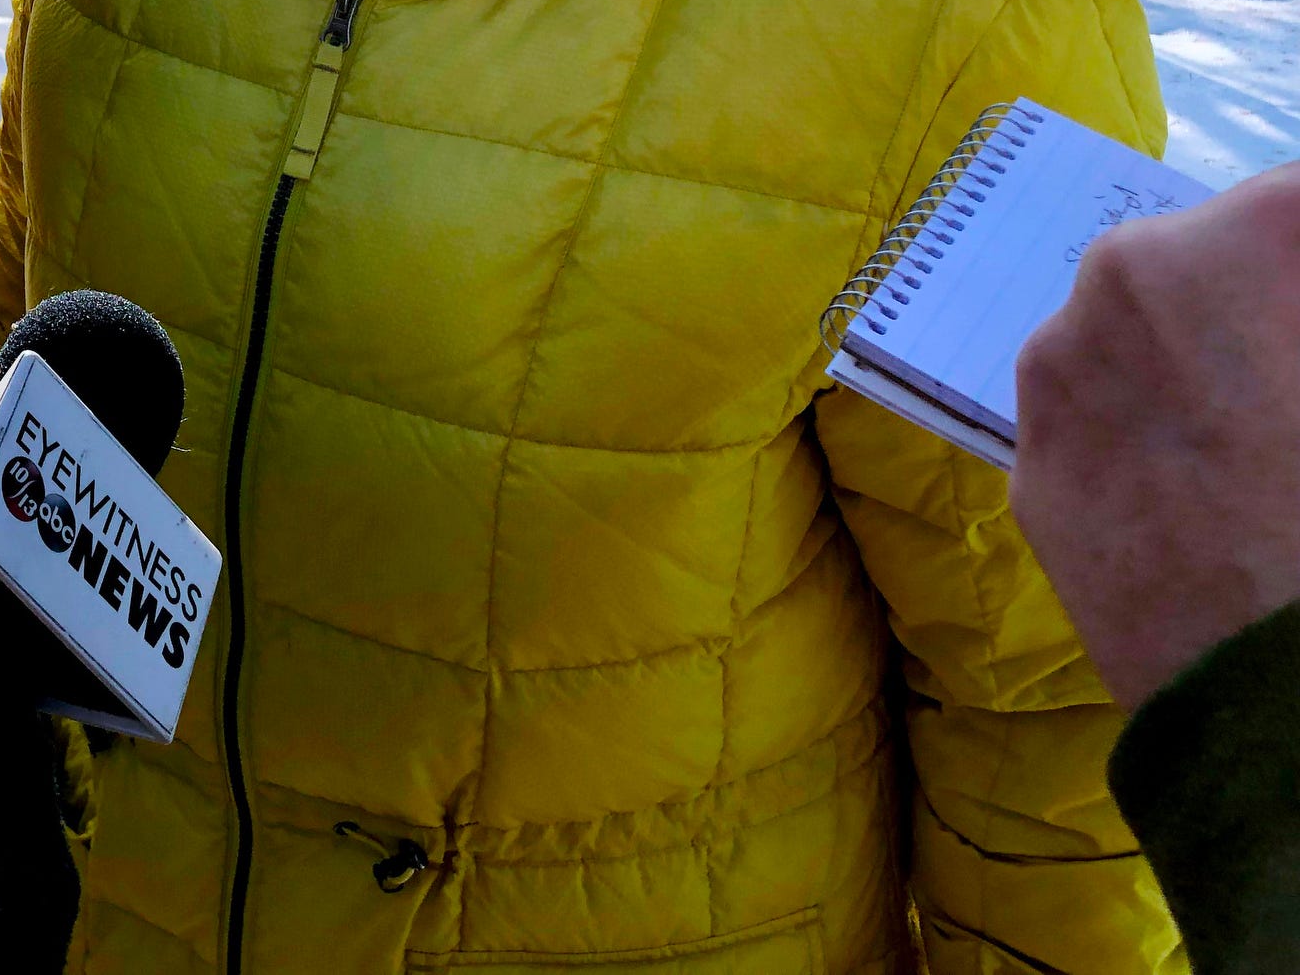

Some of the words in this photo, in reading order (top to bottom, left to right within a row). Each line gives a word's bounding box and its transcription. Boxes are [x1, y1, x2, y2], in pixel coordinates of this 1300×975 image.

[15, 411, 203, 623] EYEWITNESS
[40, 502, 74, 544] abc
[68, 522, 191, 670] NEWS
